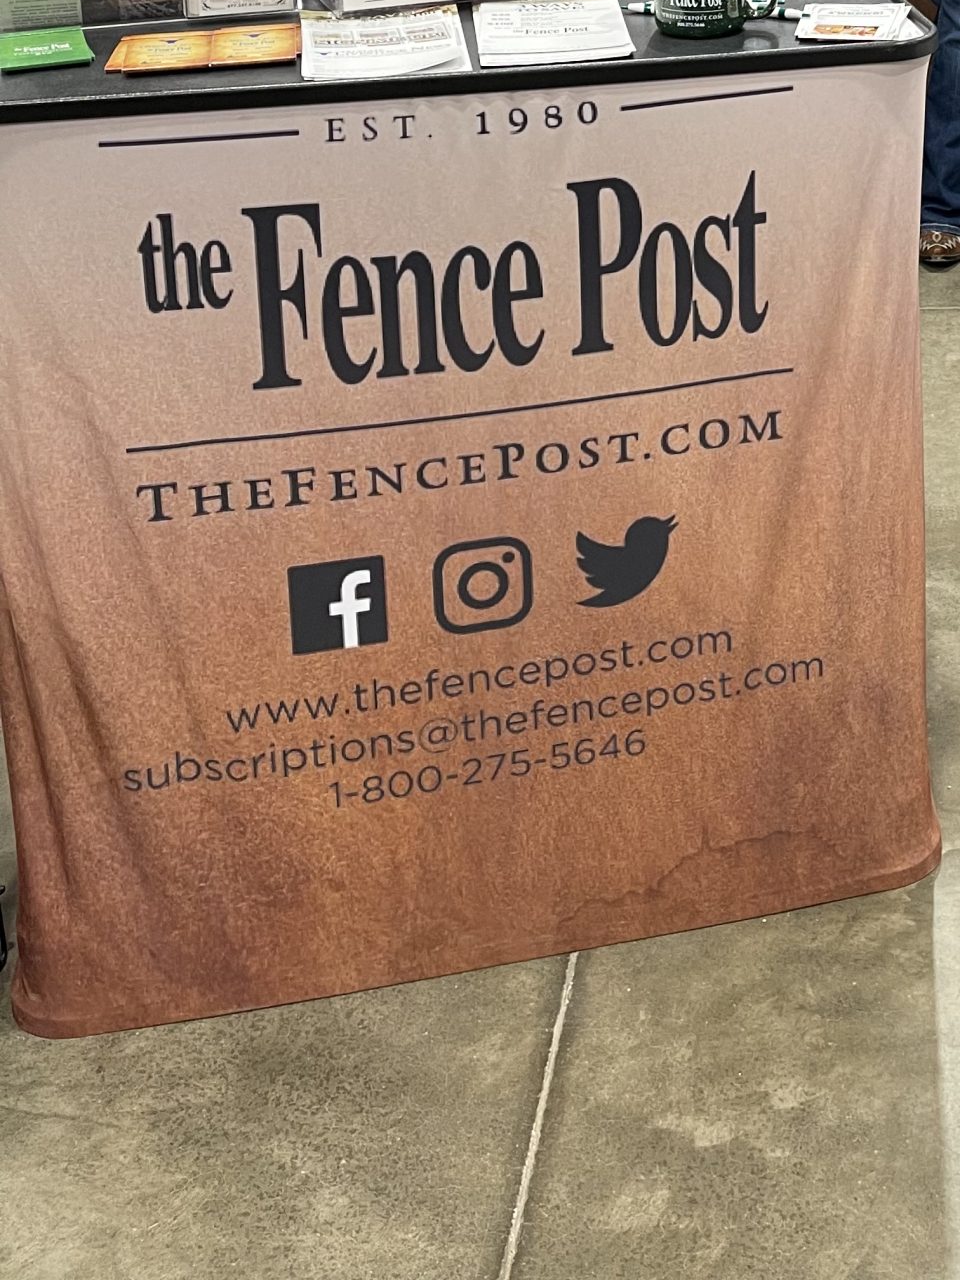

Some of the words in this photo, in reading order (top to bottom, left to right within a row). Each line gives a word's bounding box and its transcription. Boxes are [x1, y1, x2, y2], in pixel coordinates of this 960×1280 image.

[324, 113, 434, 143] EST.
[476, 100, 600, 137] 1980
[137, 213, 235, 315] the
[241, 203, 546, 391] Fence
[567, 169, 772, 358] Post
[122, 654, 826, 794] subscriptions@thefencepost.com
[225, 624, 734, 734] www.thefencepost.com
[330, 729, 648, 810] 1-800-275-5646
